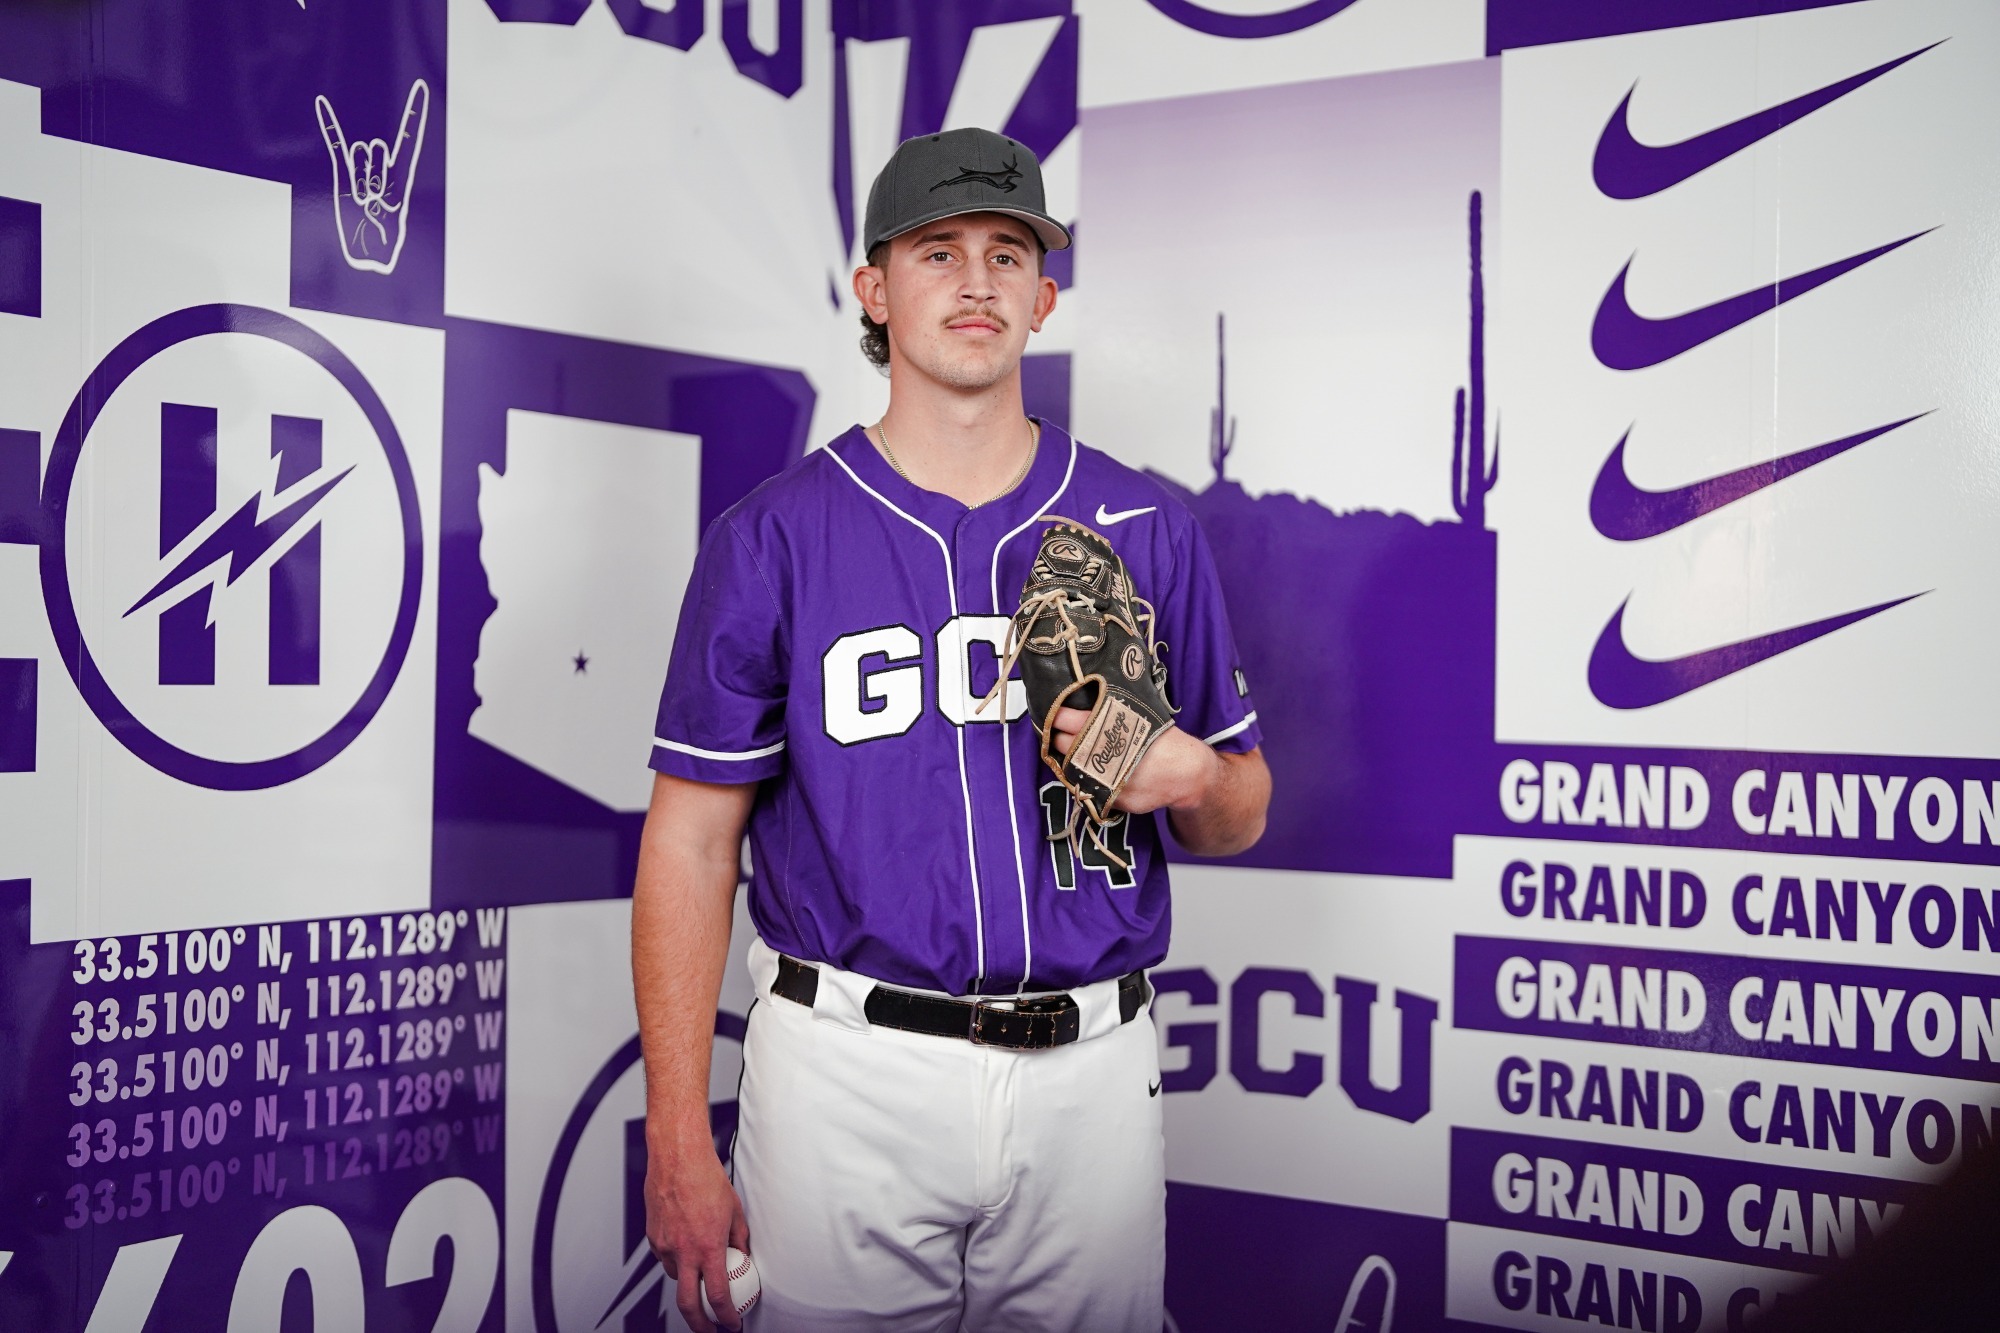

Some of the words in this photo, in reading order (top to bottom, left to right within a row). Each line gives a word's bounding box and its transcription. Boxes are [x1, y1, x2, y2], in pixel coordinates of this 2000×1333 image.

[822, 613, 1028, 748] GC
[1092, 711, 1129, 774] Rawlings
[1039, 780, 1137, 890] 14
[1499, 759, 1710, 830] GRAND
[1732, 768, 2000, 846] CANYON
[72, 927, 245, 985] 33.5100°
[258, 925, 292, 974] N,
[307, 910, 468, 963] 112.1289°
[477, 907, 505, 948] W
[1500, 859, 1707, 929] GRAND
[1732, 874, 2000, 953] CANYON
[70, 985, 244, 1045] 33.5100°
[257, 982, 291, 1030] N,
[306, 962, 467, 1018] 112.1289°
[475, 960, 504, 999] W
[1150, 964, 1439, 1124] GCU
[1495, 956, 1707, 1033] GRAND
[1729, 976, 2000, 1063] CANYON
[68, 1042, 243, 1106] 33.5100°
[256, 1038, 290, 1085] N,
[305, 1015, 465, 1074] 112.1289°
[475, 1011, 502, 1051] W
[1496, 1055, 1704, 1133] GRAND
[66, 1100, 242, 1168] 33.5100°
[254, 1095, 288, 1142] N,
[304, 1068, 464, 1130] 112.1289°
[474, 1063, 500, 1102] W
[64, 1158, 240, 1229] 33.5100°
[253, 1152, 287, 1198] N,
[473, 1116, 499, 1154] W
[1492, 1152, 1704, 1236] GRAND
[1727, 1183, 1905, 1258] CANY
[1492, 1250, 1703, 1333] GRAND
